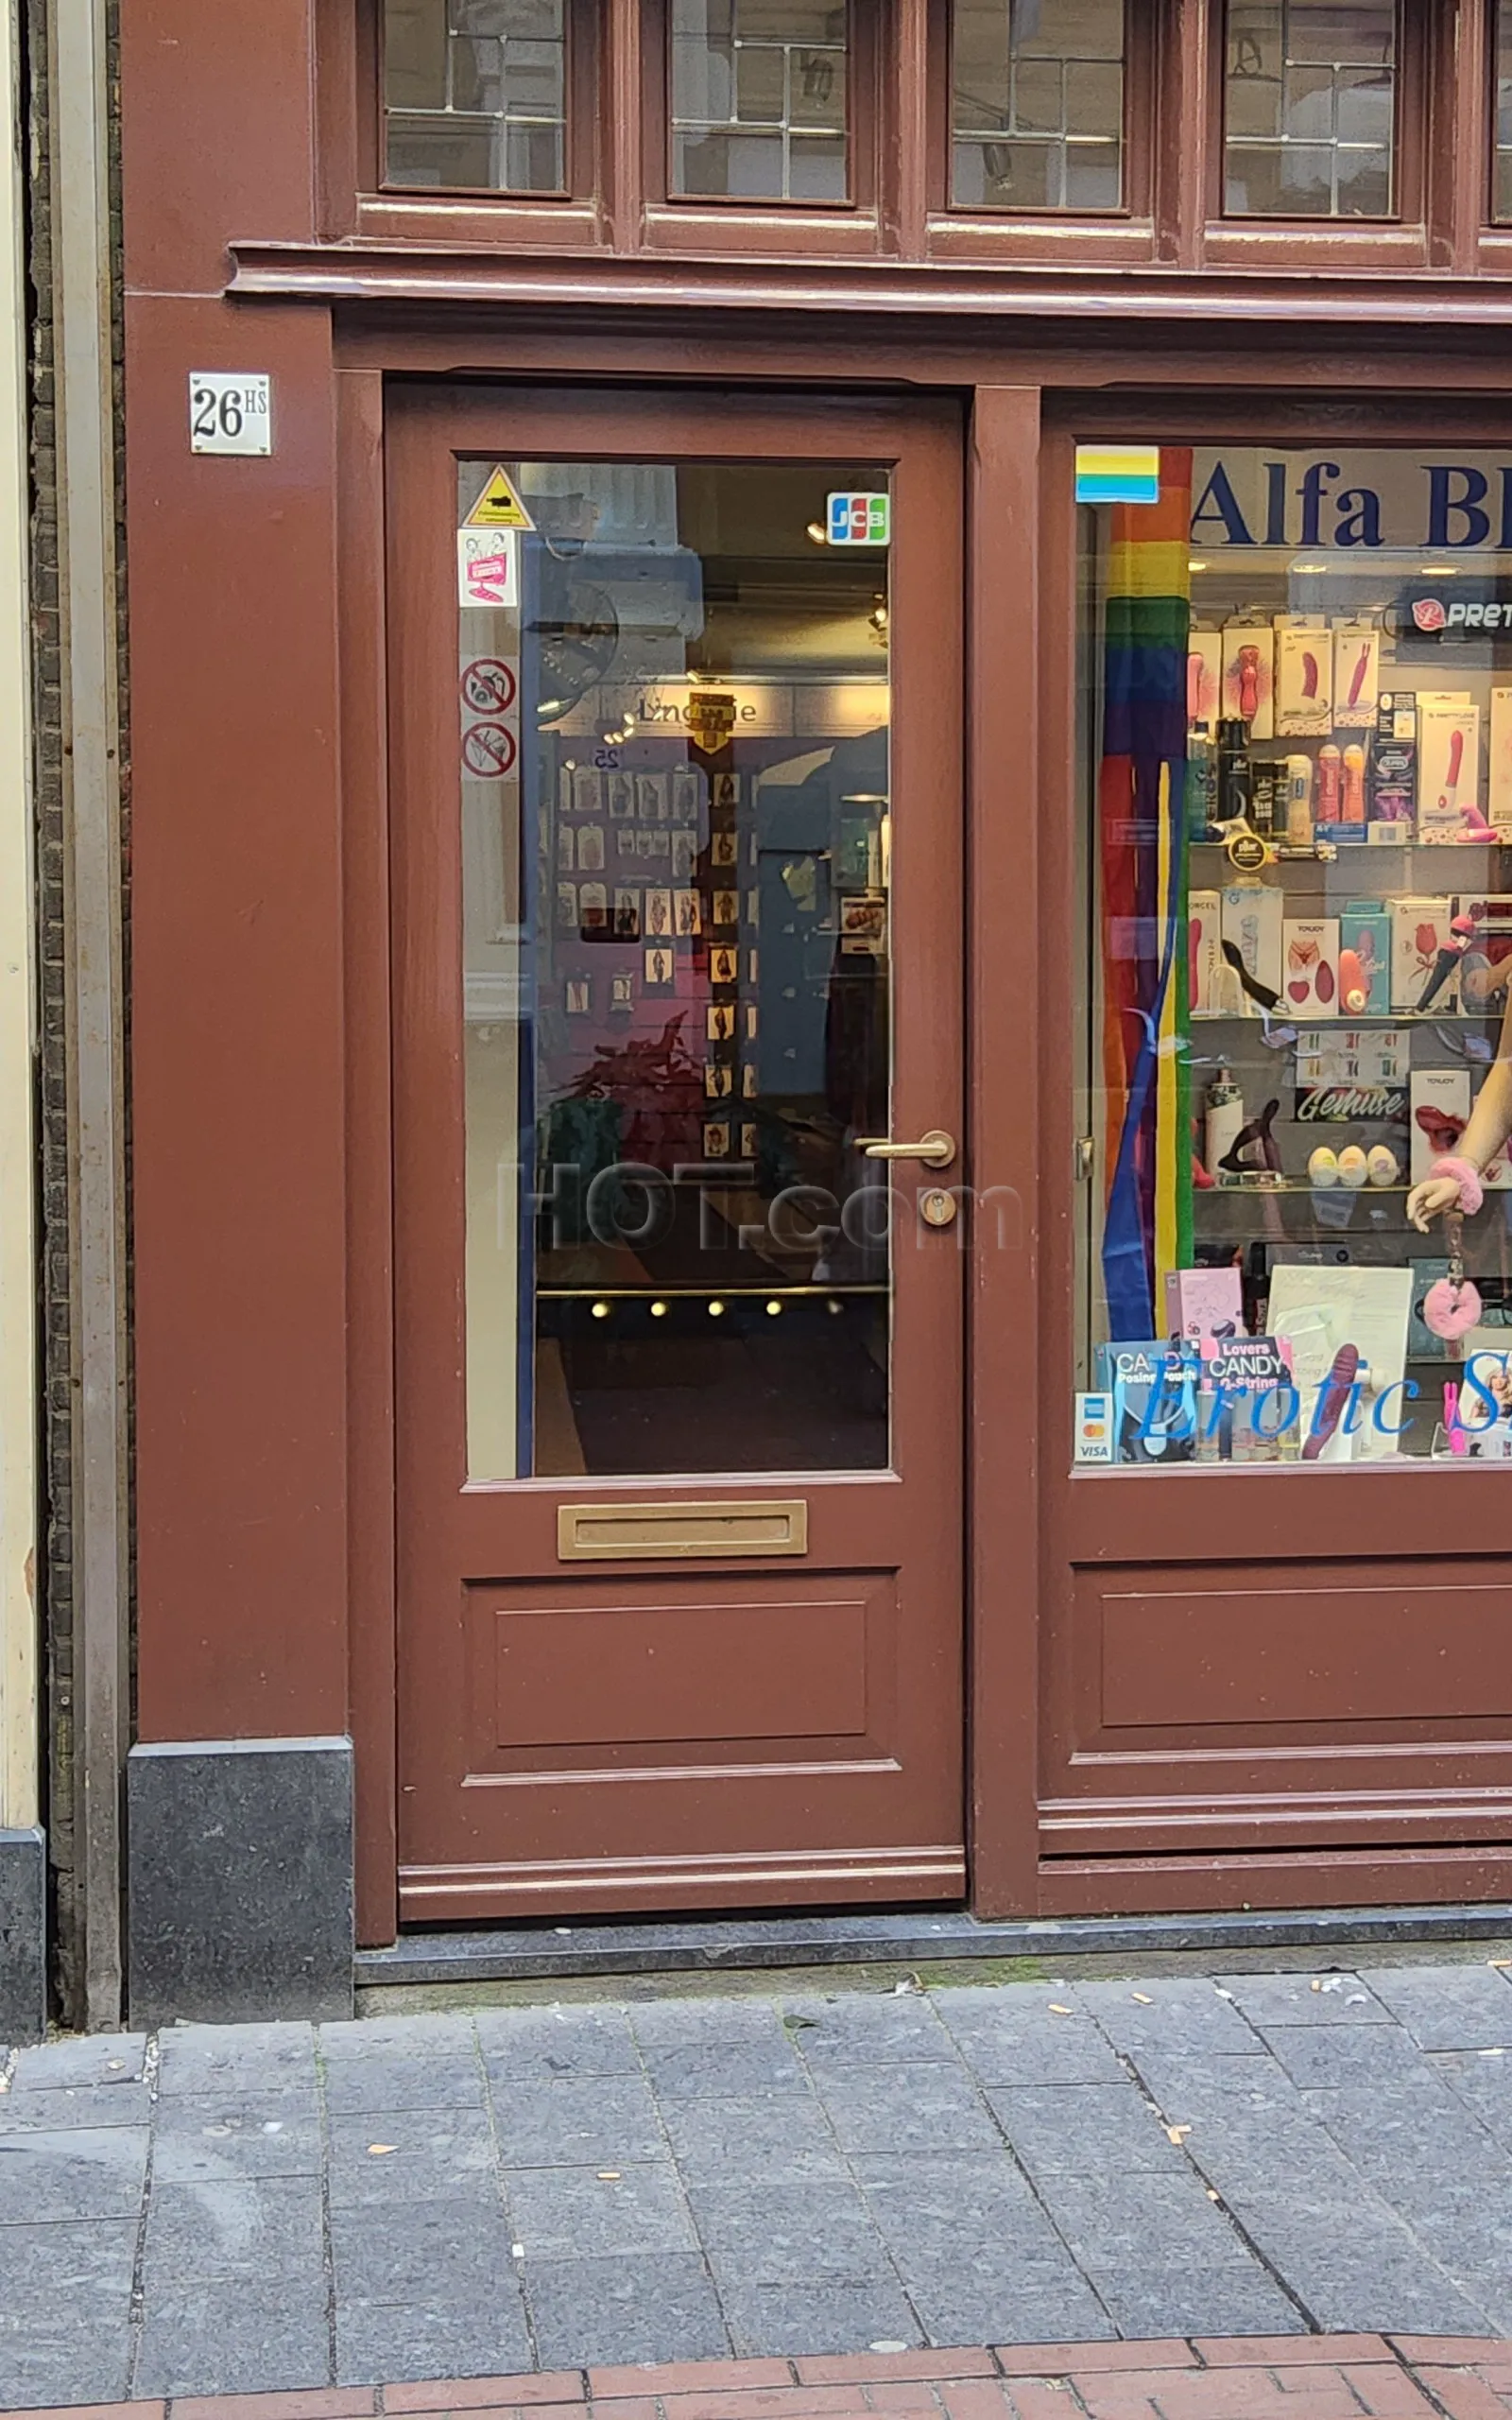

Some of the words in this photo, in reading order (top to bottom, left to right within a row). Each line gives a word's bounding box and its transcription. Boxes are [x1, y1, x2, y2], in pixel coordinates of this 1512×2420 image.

[194, 389, 242, 436] 26
[244, 389, 266, 414] HS
[1190, 460, 1385, 546] Alfa
[1222, 1343, 1270, 1356] Lovers
[1116, 1351, 1195, 1373] CADY
[1209, 1355, 1282, 1377] CANDY
[1080, 1446, 1108, 1457] VISA
